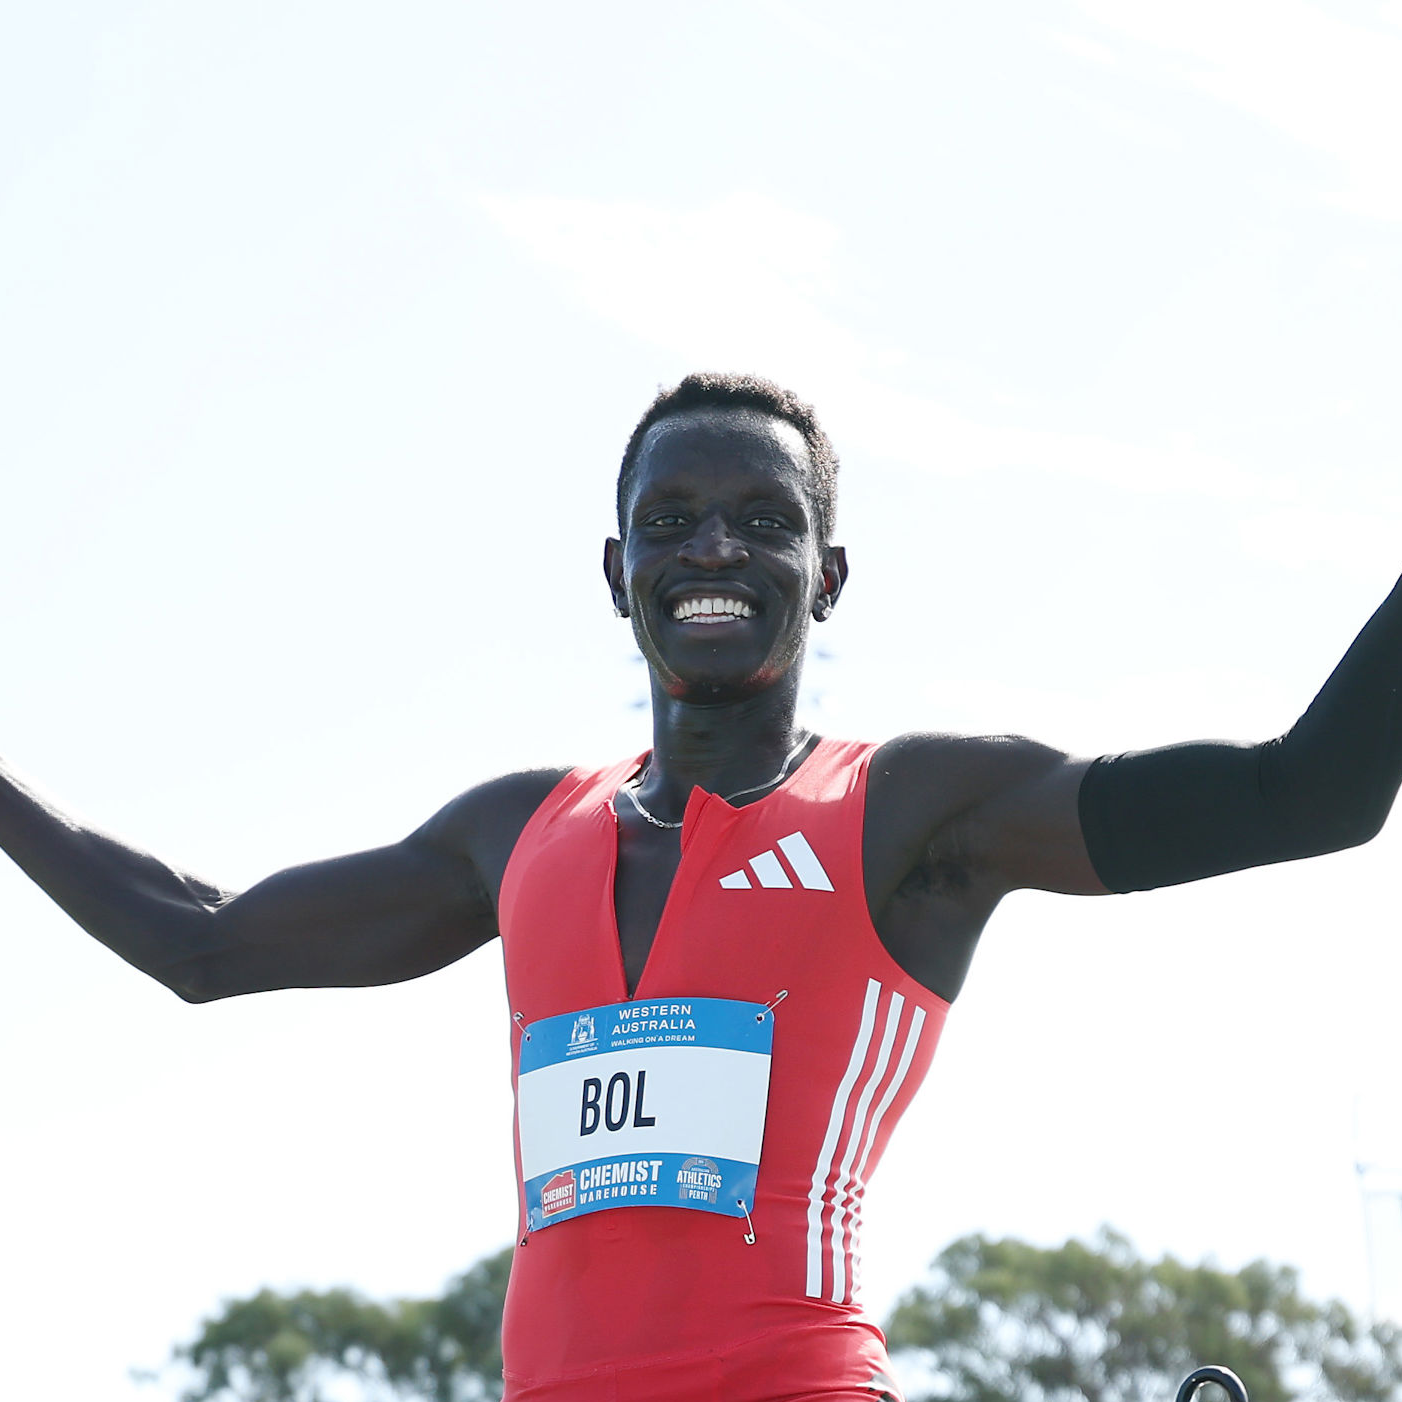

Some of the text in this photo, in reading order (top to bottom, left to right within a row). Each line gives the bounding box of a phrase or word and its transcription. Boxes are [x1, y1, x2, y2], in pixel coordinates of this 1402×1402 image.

[619, 1004, 692, 1020] WESTERN
[611, 1019, 696, 1035] AUSTRALIA
[611, 1036, 644, 1047] WALKING
[580, 1071, 656, 1136] BOL
[580, 1160, 663, 1191] CHEMIST
[676, 1169, 722, 1188] ATHLETICS
[543, 1184, 574, 1204] CHEMIST
[580, 1184, 658, 1205] WAREHOUSE
[688, 1189, 708, 1200] PERTH
